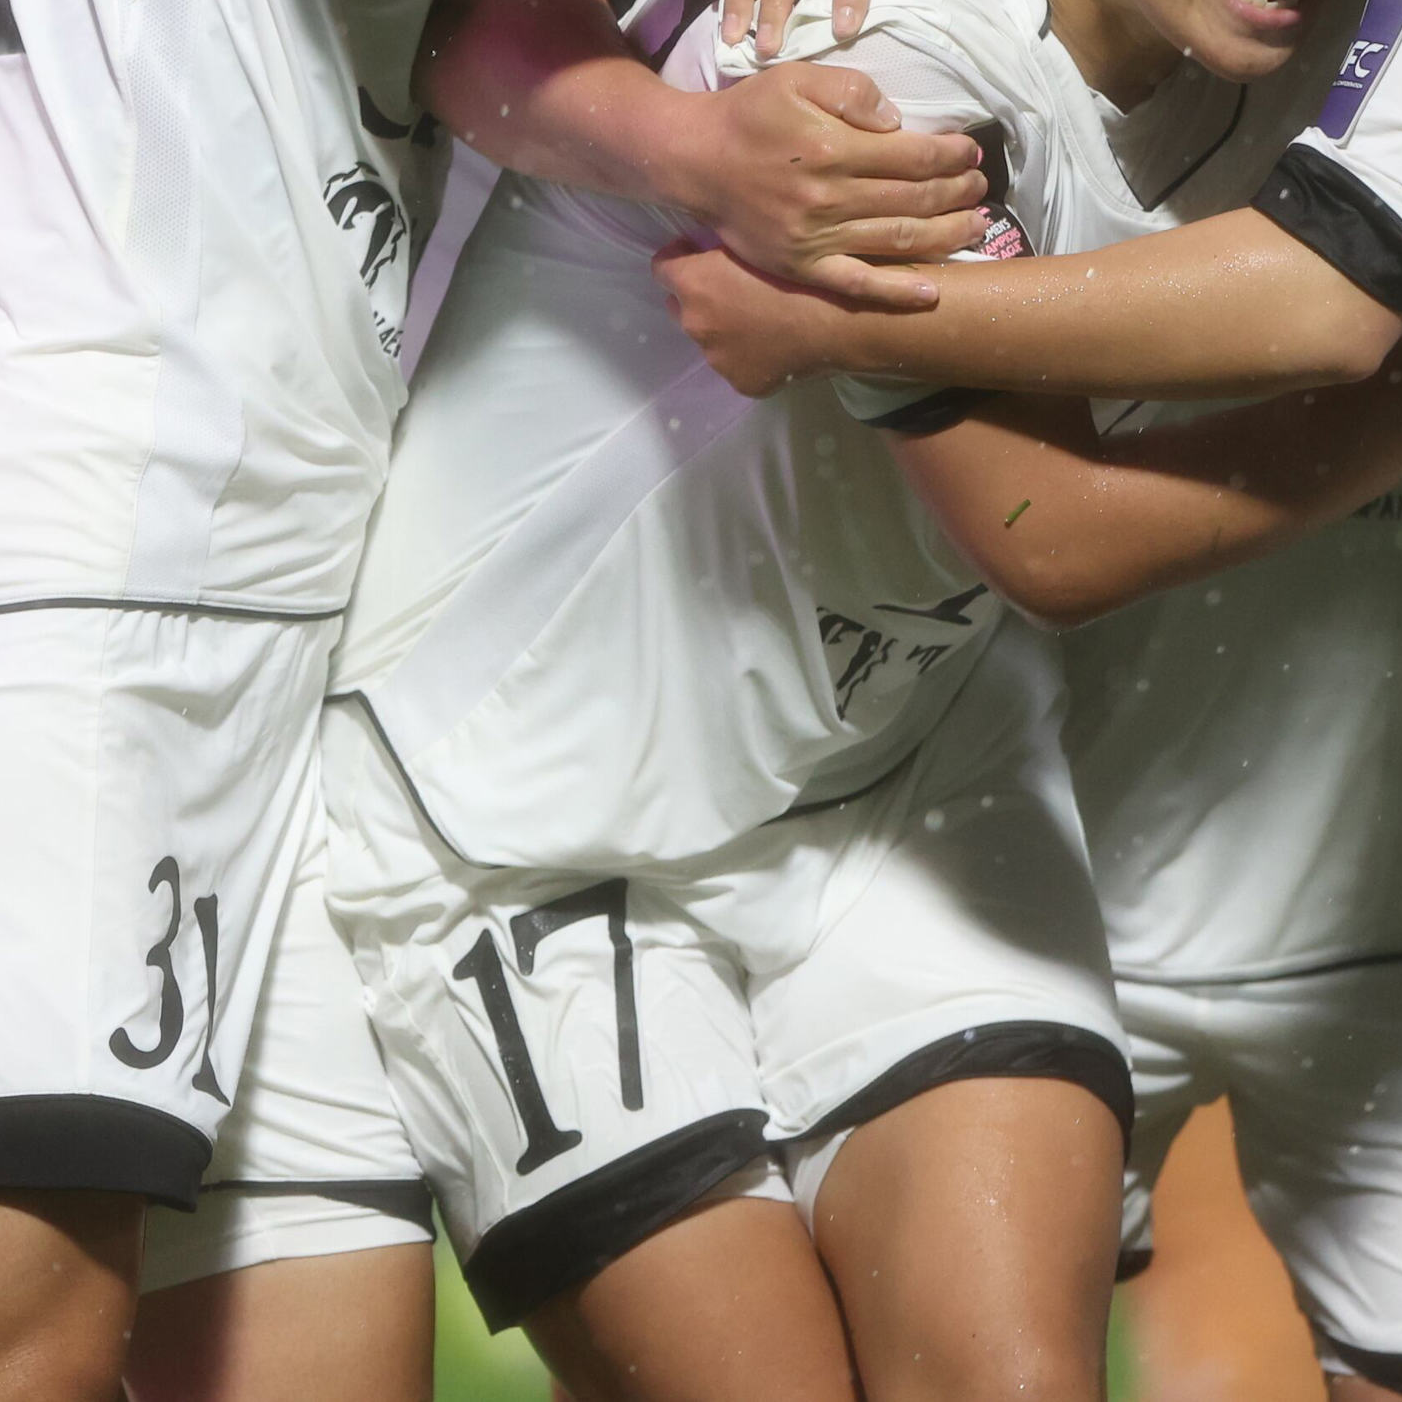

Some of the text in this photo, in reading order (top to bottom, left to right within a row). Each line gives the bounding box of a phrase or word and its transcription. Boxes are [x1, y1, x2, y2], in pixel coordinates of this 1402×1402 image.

[1339, 40, 1385, 78] FC
[109, 855, 231, 1107] 31
[453, 878, 644, 1176] 17
